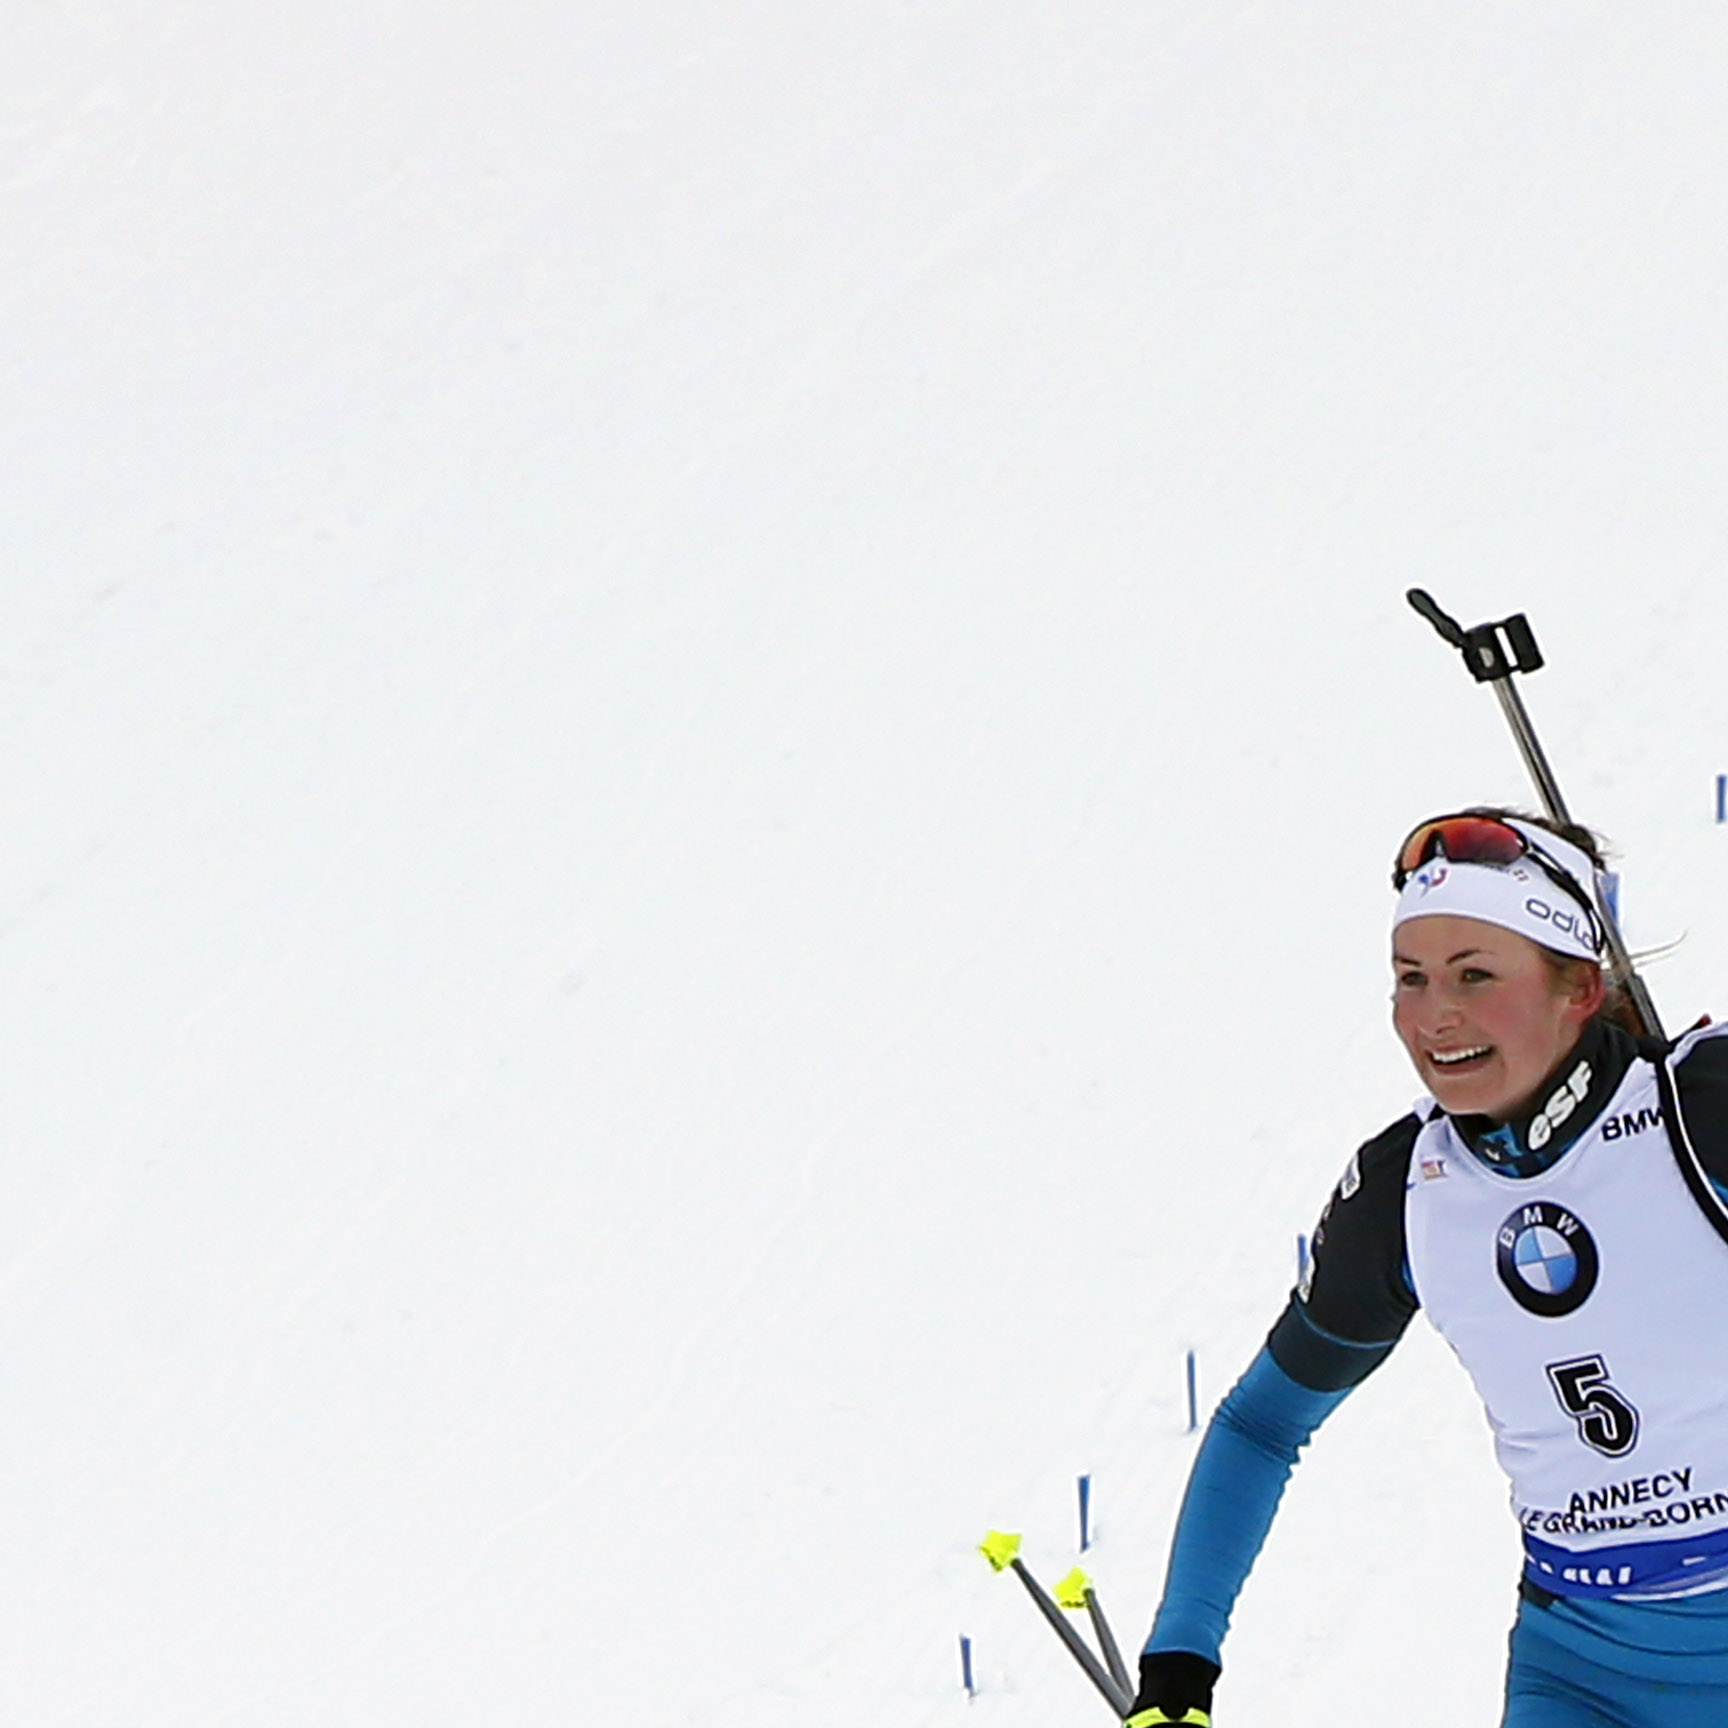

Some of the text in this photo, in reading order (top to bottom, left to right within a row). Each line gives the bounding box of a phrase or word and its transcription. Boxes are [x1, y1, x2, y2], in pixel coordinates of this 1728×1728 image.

[1601, 1106, 1666, 1141] BMW
[1499, 1204, 1580, 1249] BMW
[1546, 1353, 1640, 1457] 5
[1569, 1466, 1693, 1515] ANNECY
